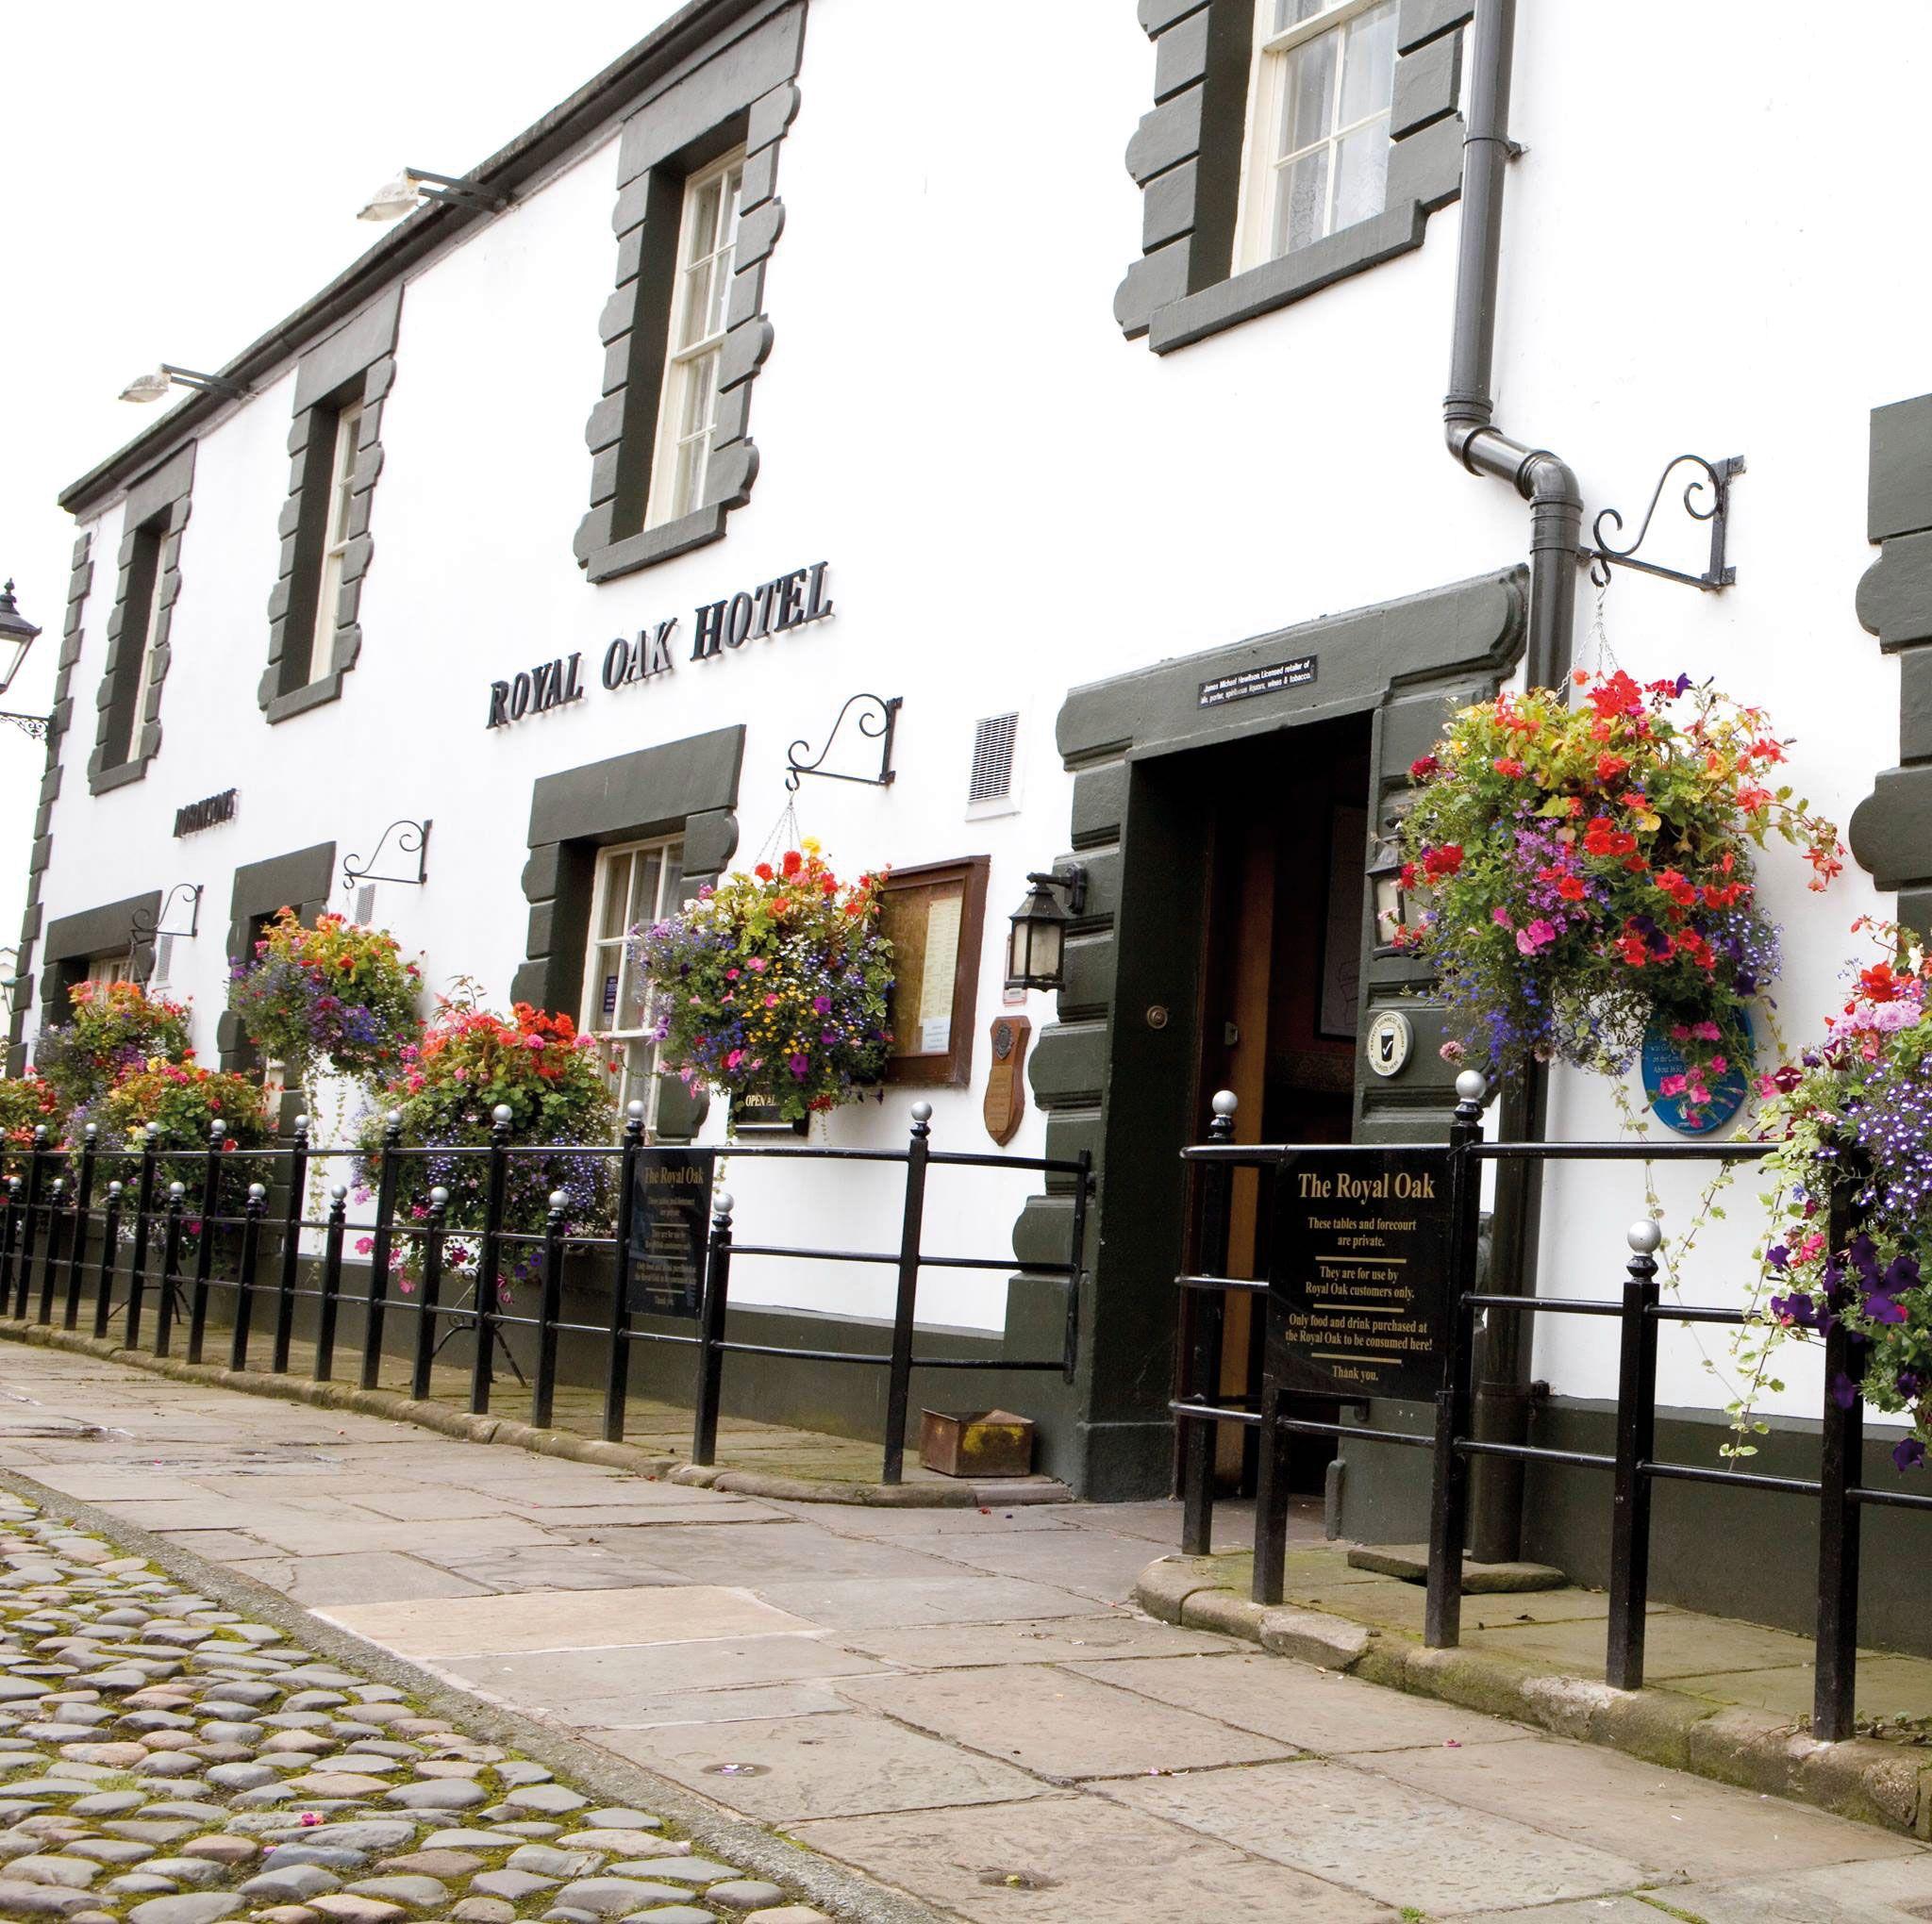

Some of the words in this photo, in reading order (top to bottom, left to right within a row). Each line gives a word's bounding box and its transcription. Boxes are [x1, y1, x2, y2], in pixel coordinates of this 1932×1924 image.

[487, 652, 584, 729] ROYAL
[602, 617, 678, 690] OAK
[690, 561, 834, 662] HOTEL
[1304, 660, 1309, 669] of
[644, 1168, 658, 1185] The
[660, 1167, 685, 1188] Royal
[687, 1167, 704, 1185] Oak
[1298, 1173, 1331, 1198] The
[1336, 1173, 1389, 1204] Royal
[1394, 1172, 1435, 1199] Oak
[1307, 1218, 1332, 1229] These
[1333, 1218, 1357, 1230] tables
[1358, 1218, 1374, 1230] and
[1376, 1219, 1417, 1231] forecourt
[1338, 1237, 1351, 1246] are
[1352, 1236, 1385, 1249] private.
[1320, 1267, 1341, 1281] They
[1342, 1270, 1356, 1279] are
[1357, 1268, 1370, 1279] for
[1372, 1270, 1385, 1280] use
[1387, 1269, 1399, 1284] by
[1306, 1282, 1328, 1297] Royal
[1331, 1283, 1348, 1295] Oak
[1350, 1285, 1392, 1297] customers
[1393, 1285, 1414, 1302] only.
[1289, 1314, 1309, 1329] Only
[1310, 1315, 1328, 1326] food
[1330, 1316, 1345, 1328] and
[1347, 1317, 1371, 1330] drink
[1372, 1319, 1416, 1333] purchased
[1418, 1322, 1427, 1333] at
[1285, 1330, 1298, 1341] the
[1300, 1331, 1323, 1346] Royal
[1324, 1332, 1341, 1344] Oak
[1343, 1335, 1352, 1345] to
[1354, 1335, 1364, 1346] be
[1366, 1336, 1407, 1349] consumed
[1409, 1338, 1432, 1351] here!
[1332, 1366, 1358, 1379] Thank
[1360, 1370, 1378, 1383] you.
